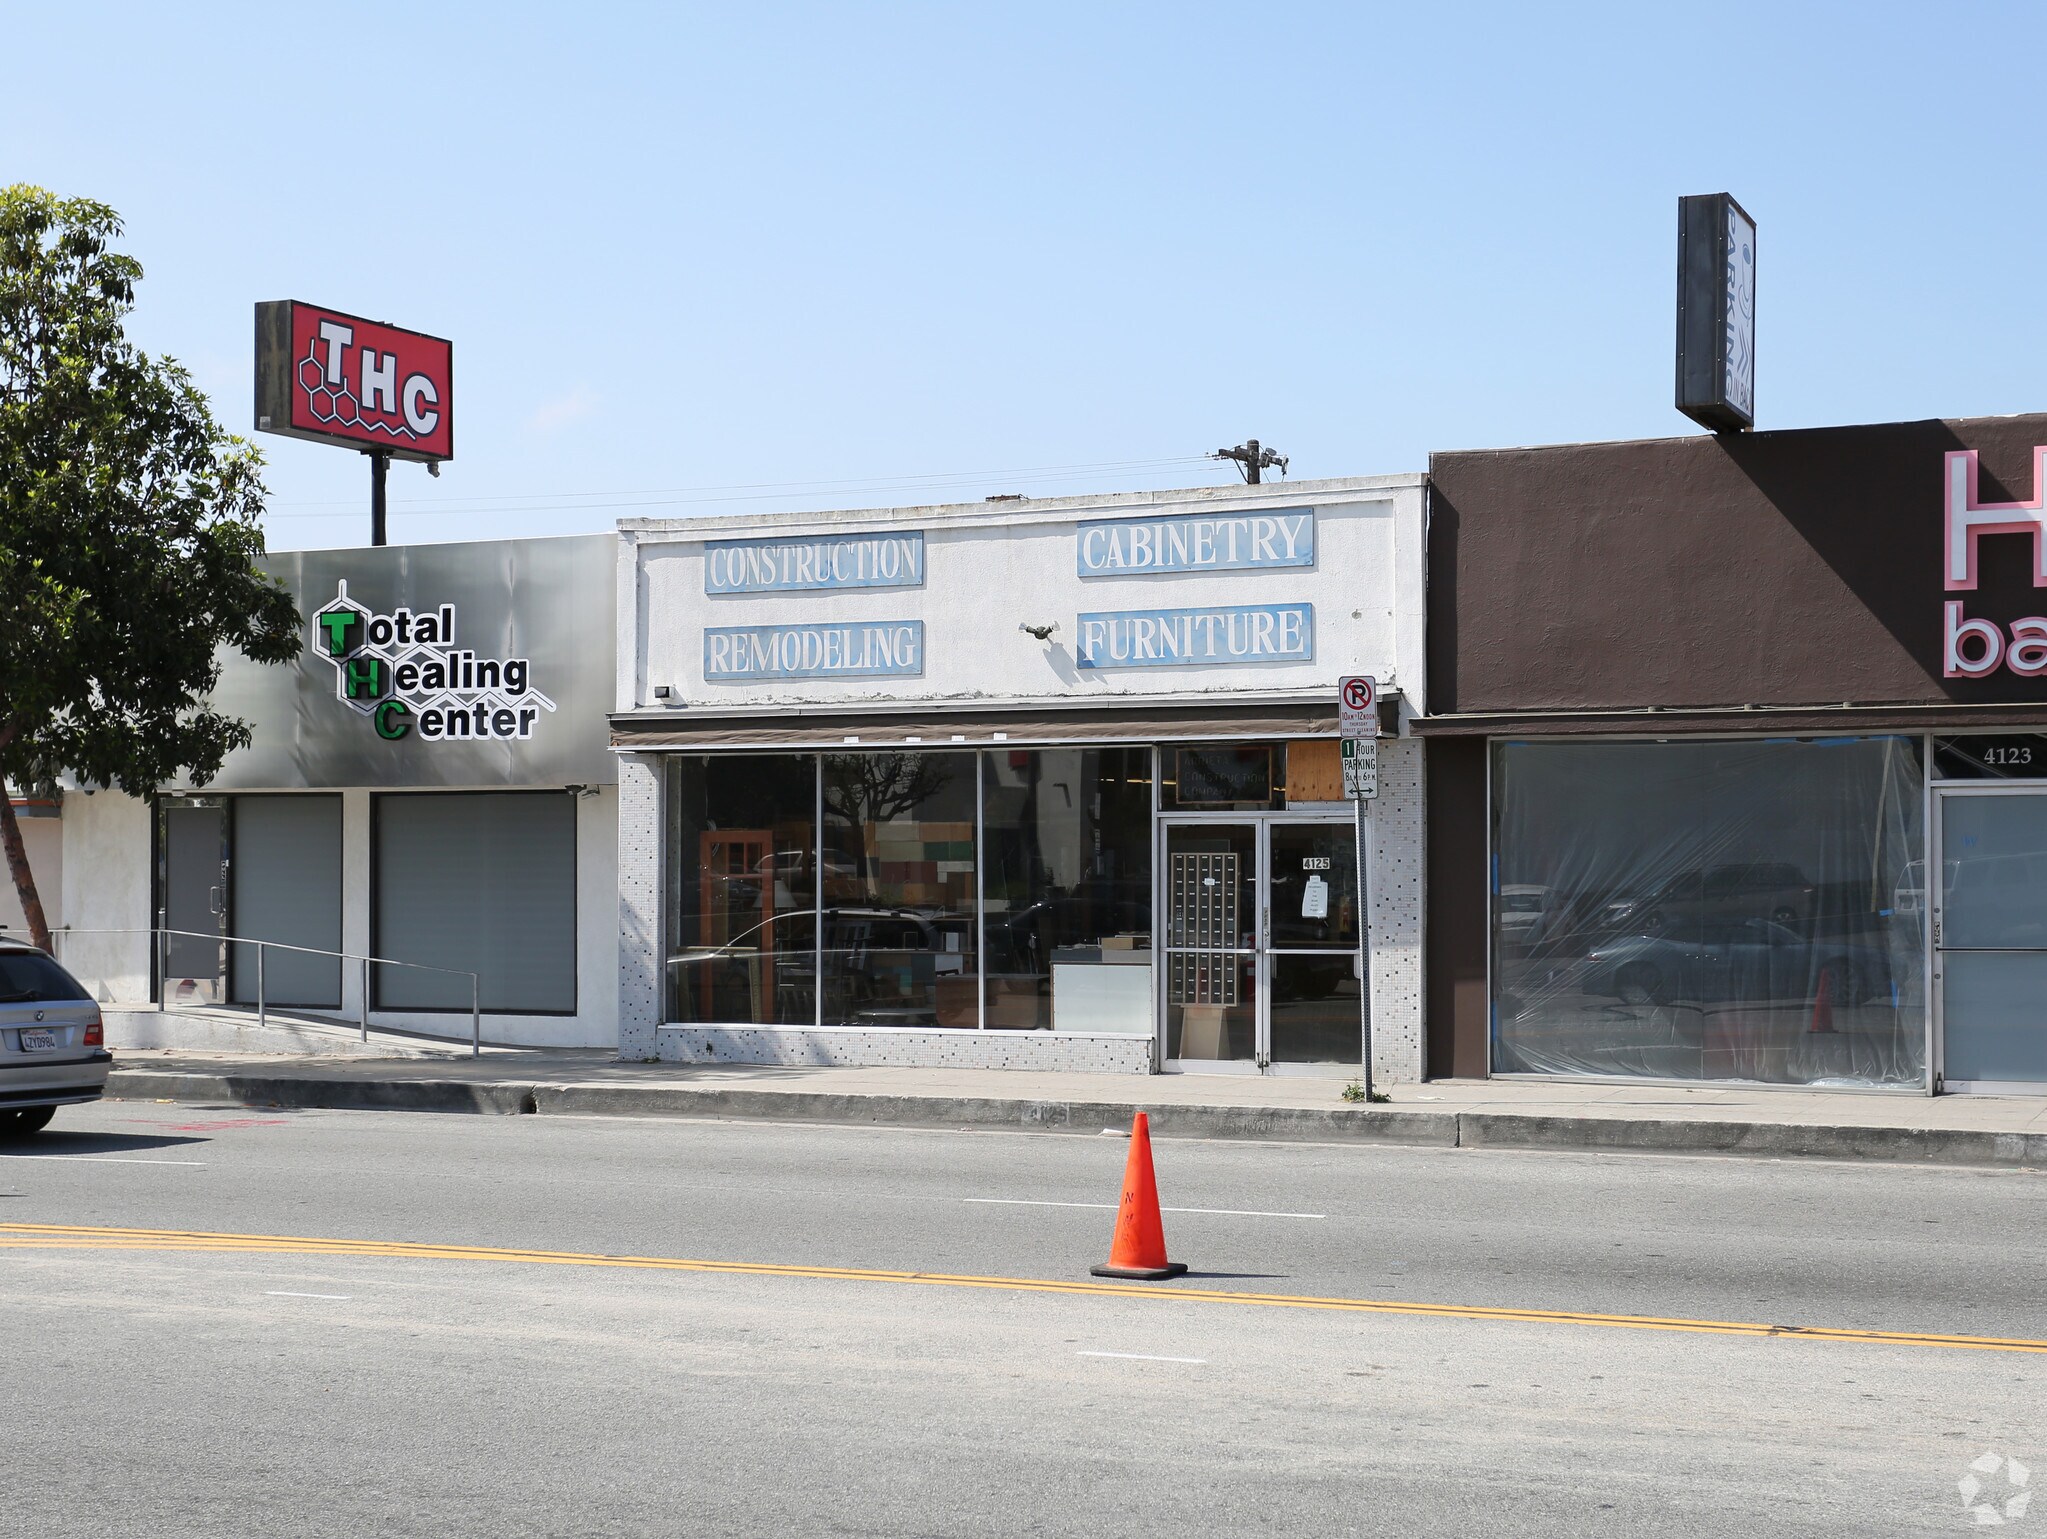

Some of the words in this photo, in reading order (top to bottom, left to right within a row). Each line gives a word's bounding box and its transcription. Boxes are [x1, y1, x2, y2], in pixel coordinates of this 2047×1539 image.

[1726, 206, 1736, 397] PARKING
[318, 318, 440, 435] THC
[710, 538, 918, 588] CONSTRUCTION
[1083, 514, 1306, 570] CABINETRY
[321, 609, 452, 657] Total
[709, 626, 916, 674] REMODELING
[1083, 610, 1305, 662] FURNITURE
[347, 654, 527, 698] Healing
[374, 700, 535, 740] Center
[1344, 758, 1376, 771] PARKING
[1346, 742, 1350, 756] 1
[1357, 745, 1375, 755] HOUR
[1983, 747, 2032, 764] 4123
[1184, 771, 1265, 784] CONSTRUCTION
[1304, 858, 1329, 869] 4125
